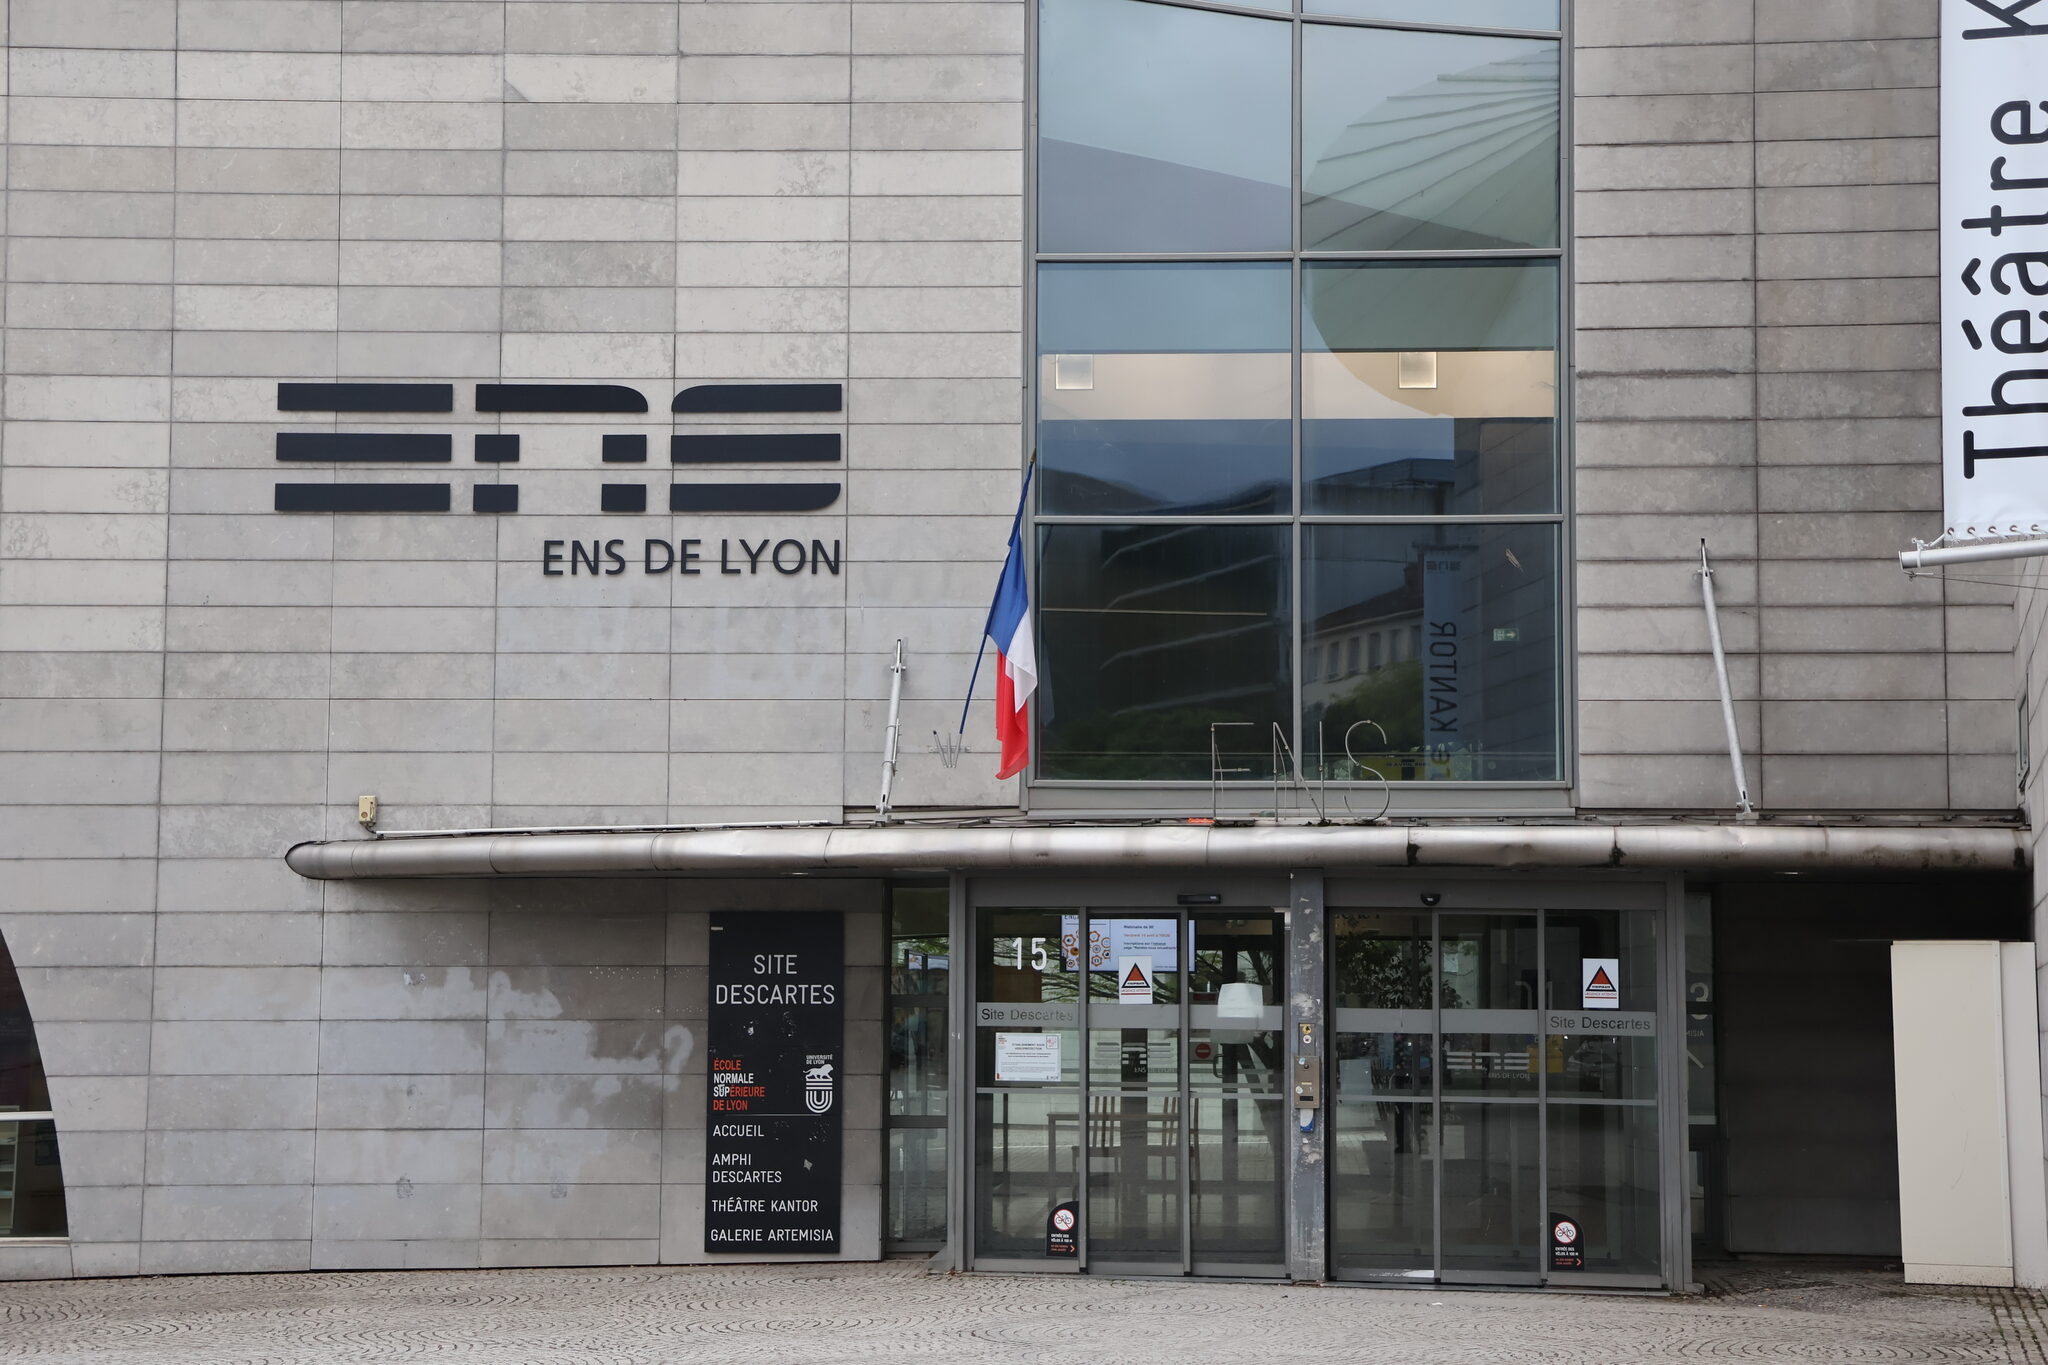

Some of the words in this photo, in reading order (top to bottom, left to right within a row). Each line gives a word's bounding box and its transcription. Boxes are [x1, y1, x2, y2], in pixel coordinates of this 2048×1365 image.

[1961, 99, 2048, 480] Théâtre
[543, 538, 626, 576] ENS
[644, 538, 702, 576] DE
[720, 538, 841, 576] LYON
[1012, 937, 1048, 971] 15
[753, 954, 798, 975] SITE
[715, 984, 835, 1005] DESCARTES
[981, 1008, 1004, 1020] Site
[1010, 1009, 1073, 1021] Descartes
[1550, 1015, 1575, 1029] Site
[1581, 1016, 1651, 1030] Descartes
[714, 1057, 742, 1070] ÉCOLE
[713, 1073, 754, 1084] NORMALE
[713, 1085, 766, 1097] SUPÉRIEURE
[713, 1099, 725, 1111] DE
[726, 1099, 748, 1111] LYON
[712, 1124, 765, 1137] ACCUEIL
[712, 1153, 752, 1166] AMPHI
[712, 1170, 782, 1183] DESCARTES
[711, 1196, 766, 1212] THÉÂTRE
[770, 1199, 818, 1212] KANTOR
[710, 1229, 763, 1242] GALERIE
[767, 1229, 834, 1242] ARTEMISIA
